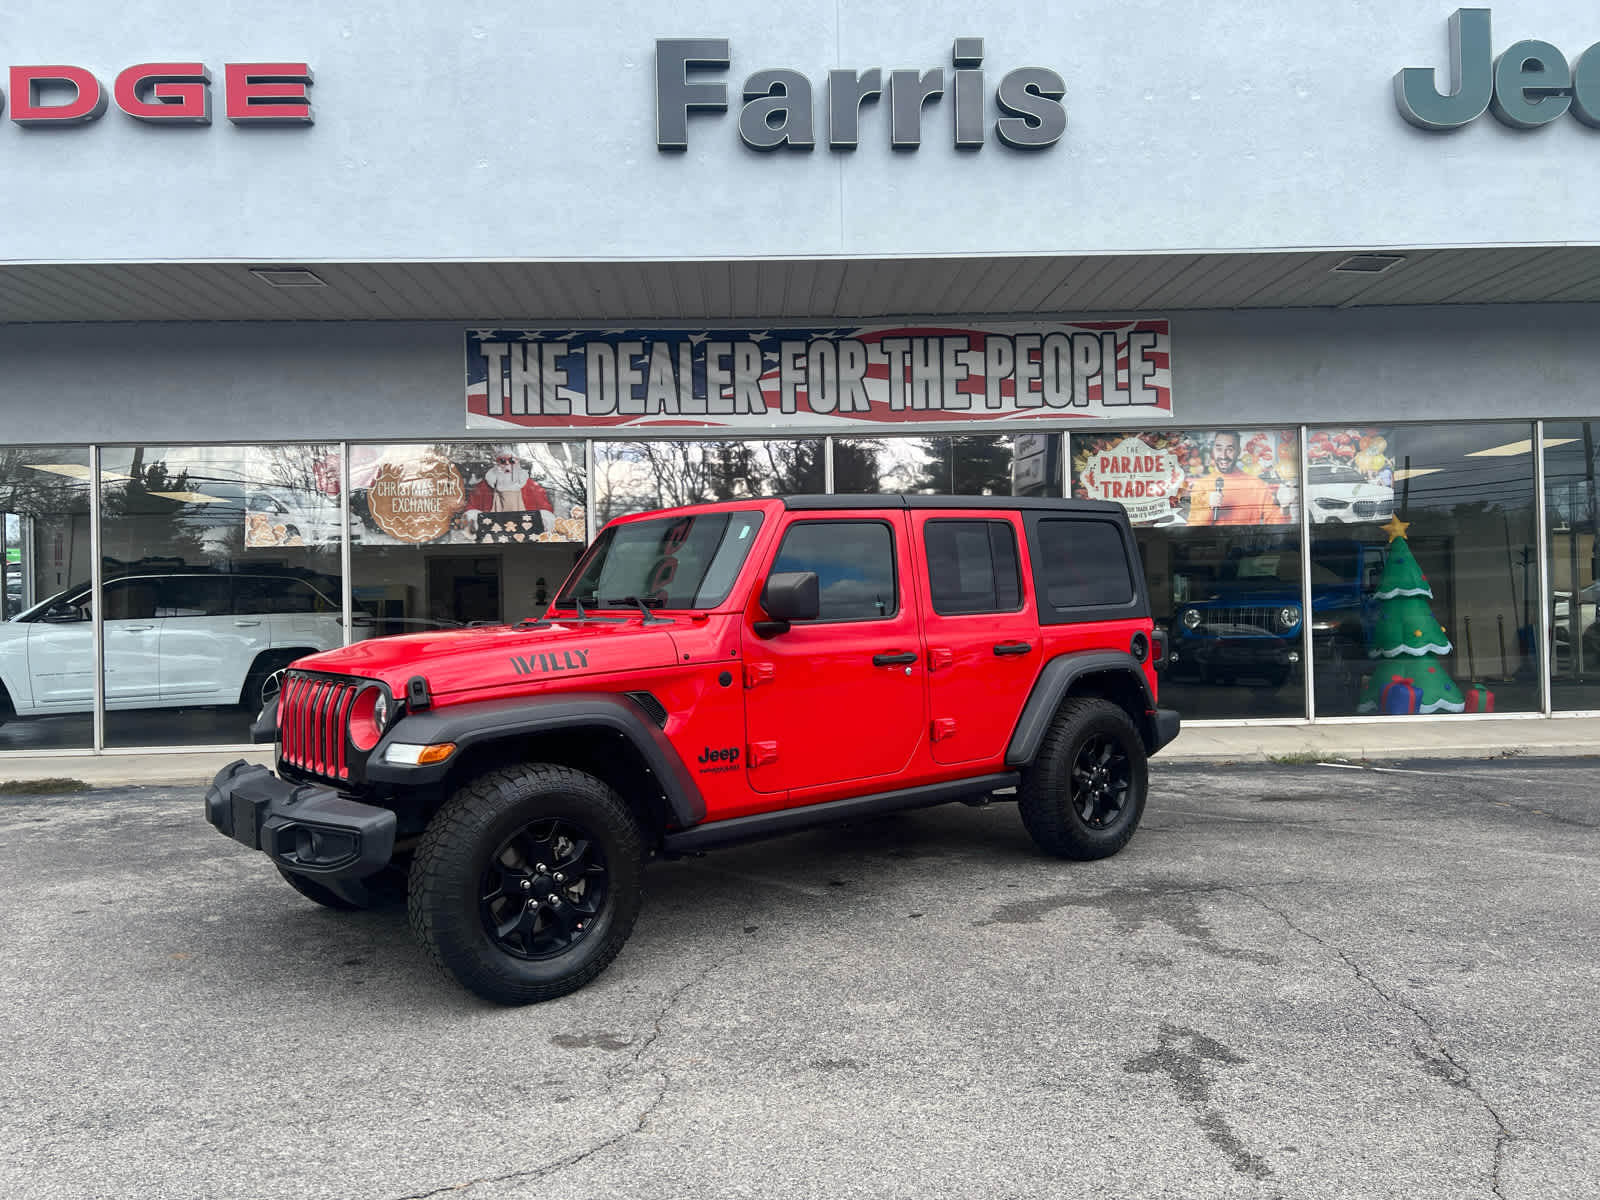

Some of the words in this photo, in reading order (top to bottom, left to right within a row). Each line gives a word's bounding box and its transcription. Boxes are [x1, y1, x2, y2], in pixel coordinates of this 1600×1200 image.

[0, 62, 313, 126] DGE
[655, 37, 1068, 151] Farris
[480, 341, 572, 416] THE
[583, 340, 769, 415] DEALER
[780, 338, 871, 414] FOR
[880, 335, 971, 410] THE
[984, 331, 1158, 409] PEOPLE
[1100, 455, 1165, 474] PARADE
[377, 480, 433, 497] CHRISTMAS
[436, 480, 457, 496] CAR
[1099, 480, 1166, 498] TRADES
[391, 497, 443, 513] EXCHANGE
[509, 649, 589, 675] WILLY
[698, 746, 739, 763] Jeep
